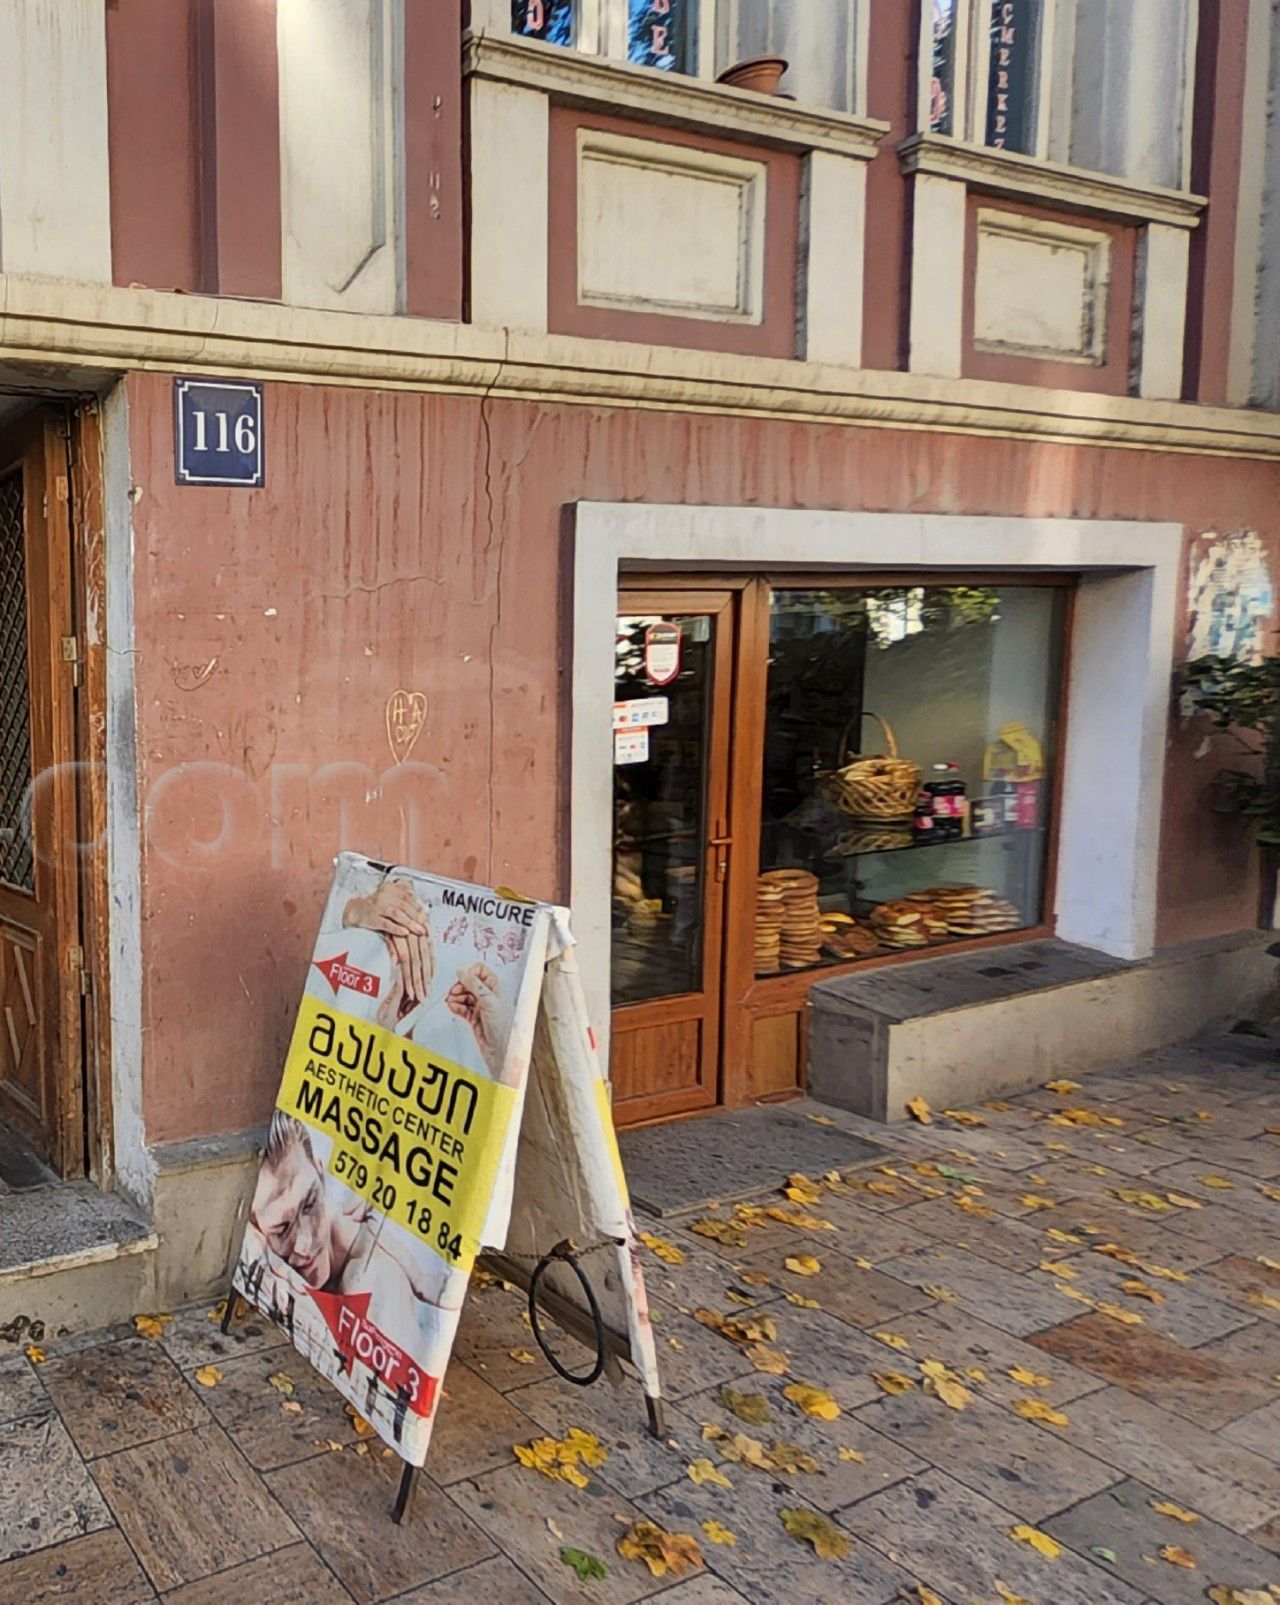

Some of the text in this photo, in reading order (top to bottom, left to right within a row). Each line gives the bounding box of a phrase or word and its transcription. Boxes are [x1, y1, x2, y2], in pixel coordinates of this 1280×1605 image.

[192, 410, 256, 454] 116
[441, 889, 536, 927] MANICURE
[330, 963, 361, 988] Floor
[362, 976, 374, 993] 3
[304, 1059, 465, 1164] AESTHETIC CENTER
[308, 1012, 479, 1136] მასაჟი
[296, 1080, 460, 1207] MASSAGE
[334, 1151, 464, 1261] 579 20 18 84
[337, 1305, 401, 1380] Floor
[404, 1365, 420, 1402] 3
